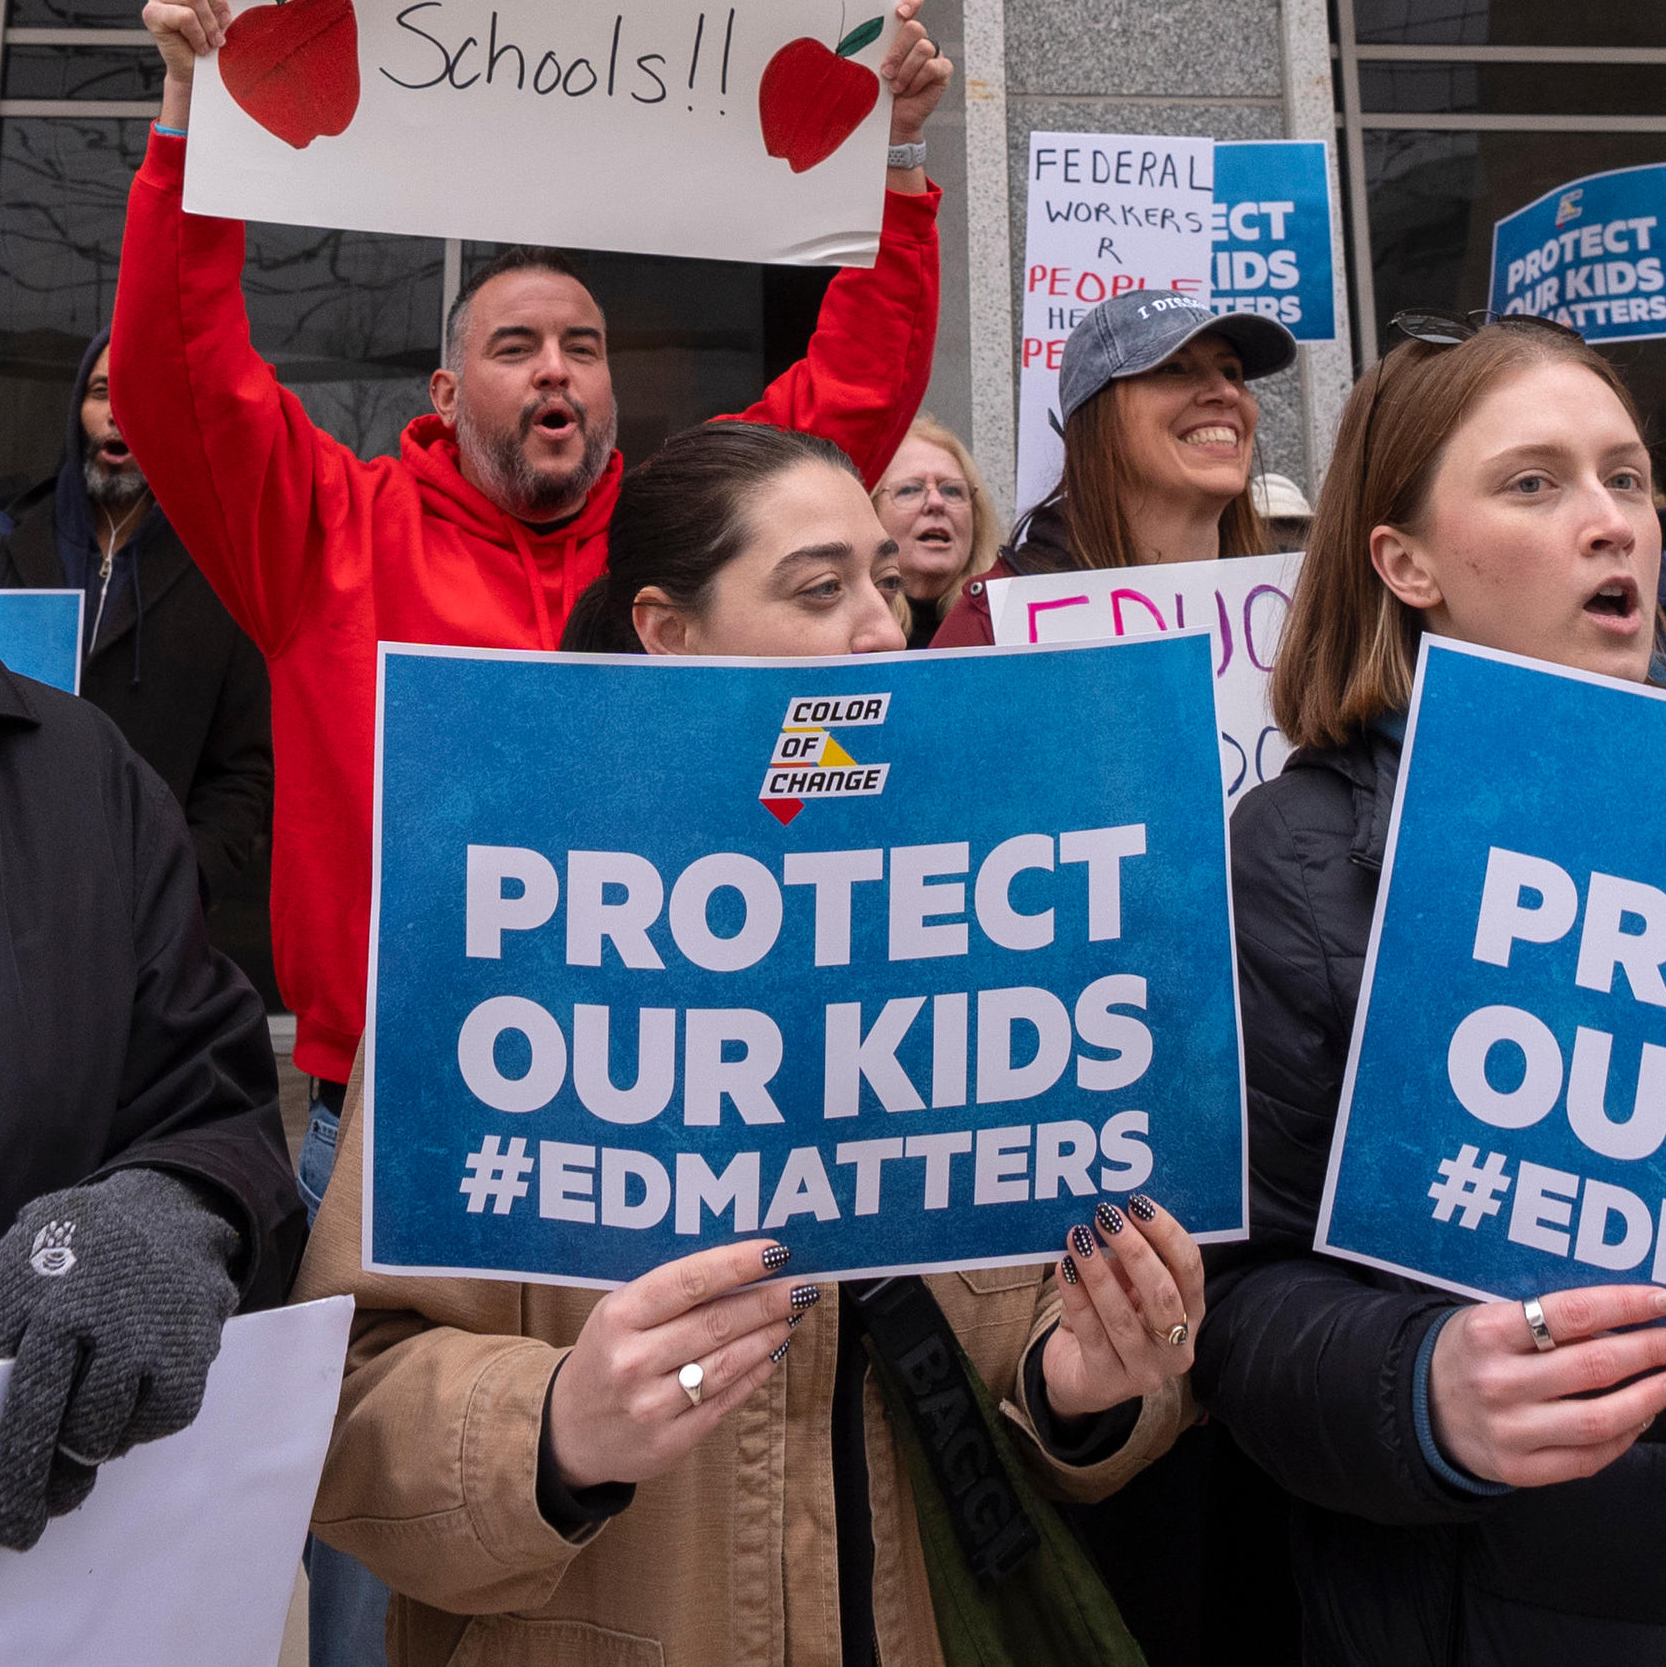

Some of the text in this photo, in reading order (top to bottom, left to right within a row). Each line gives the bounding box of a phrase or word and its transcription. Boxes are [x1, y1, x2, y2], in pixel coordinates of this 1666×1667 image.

[379, 2, 735, 115] Schools!!
[1035, 149, 1213, 191] FEDERAL
[1046, 201, 1203, 233] WORKERS
[1098, 237, 1123, 263] R
[1211, 250, 1300, 290] IDS
[1507, 216, 1658, 294] PROTECT
[1506, 257, 1665, 316] OUR KIDS
[793, 699, 882, 722] COLOR
[781, 737, 819, 758] OF
[769, 769, 881, 793] CHANGE
[465, 823, 1148, 972] PROTECT
[457, 974, 1154, 1126] OUR KIDS
[459, 1110, 1154, 1235] #EDMATTERS
